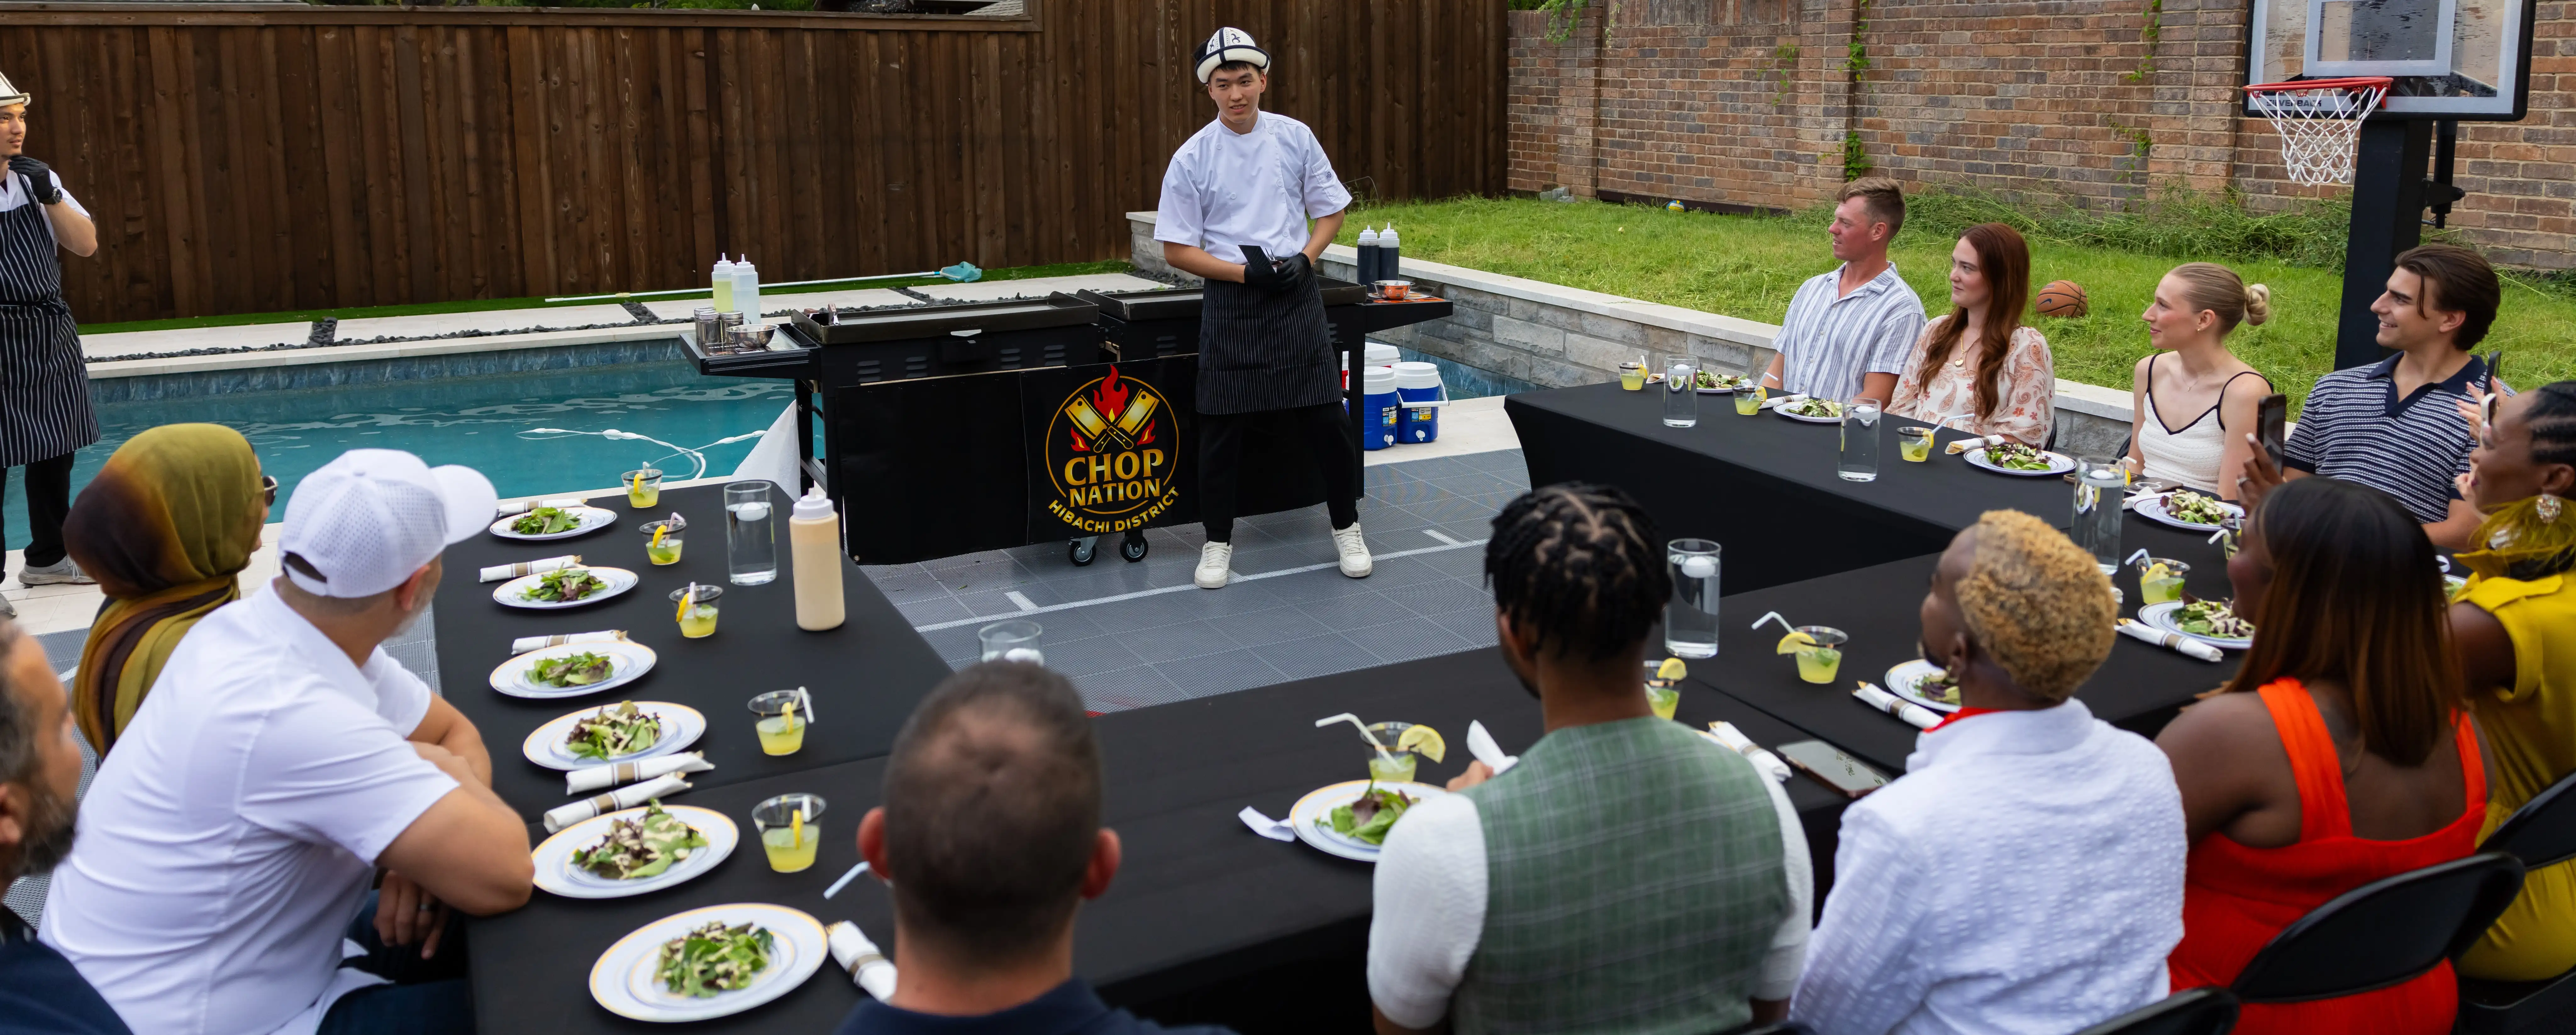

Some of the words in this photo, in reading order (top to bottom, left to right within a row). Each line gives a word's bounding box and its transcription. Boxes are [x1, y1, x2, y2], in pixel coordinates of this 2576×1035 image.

[1064, 449, 1164, 486] CHOP
[1048, 499, 1110, 532] HIBACHI
[1115, 486, 1179, 531] DISTRICT
[1069, 478, 1160, 508] NATION
